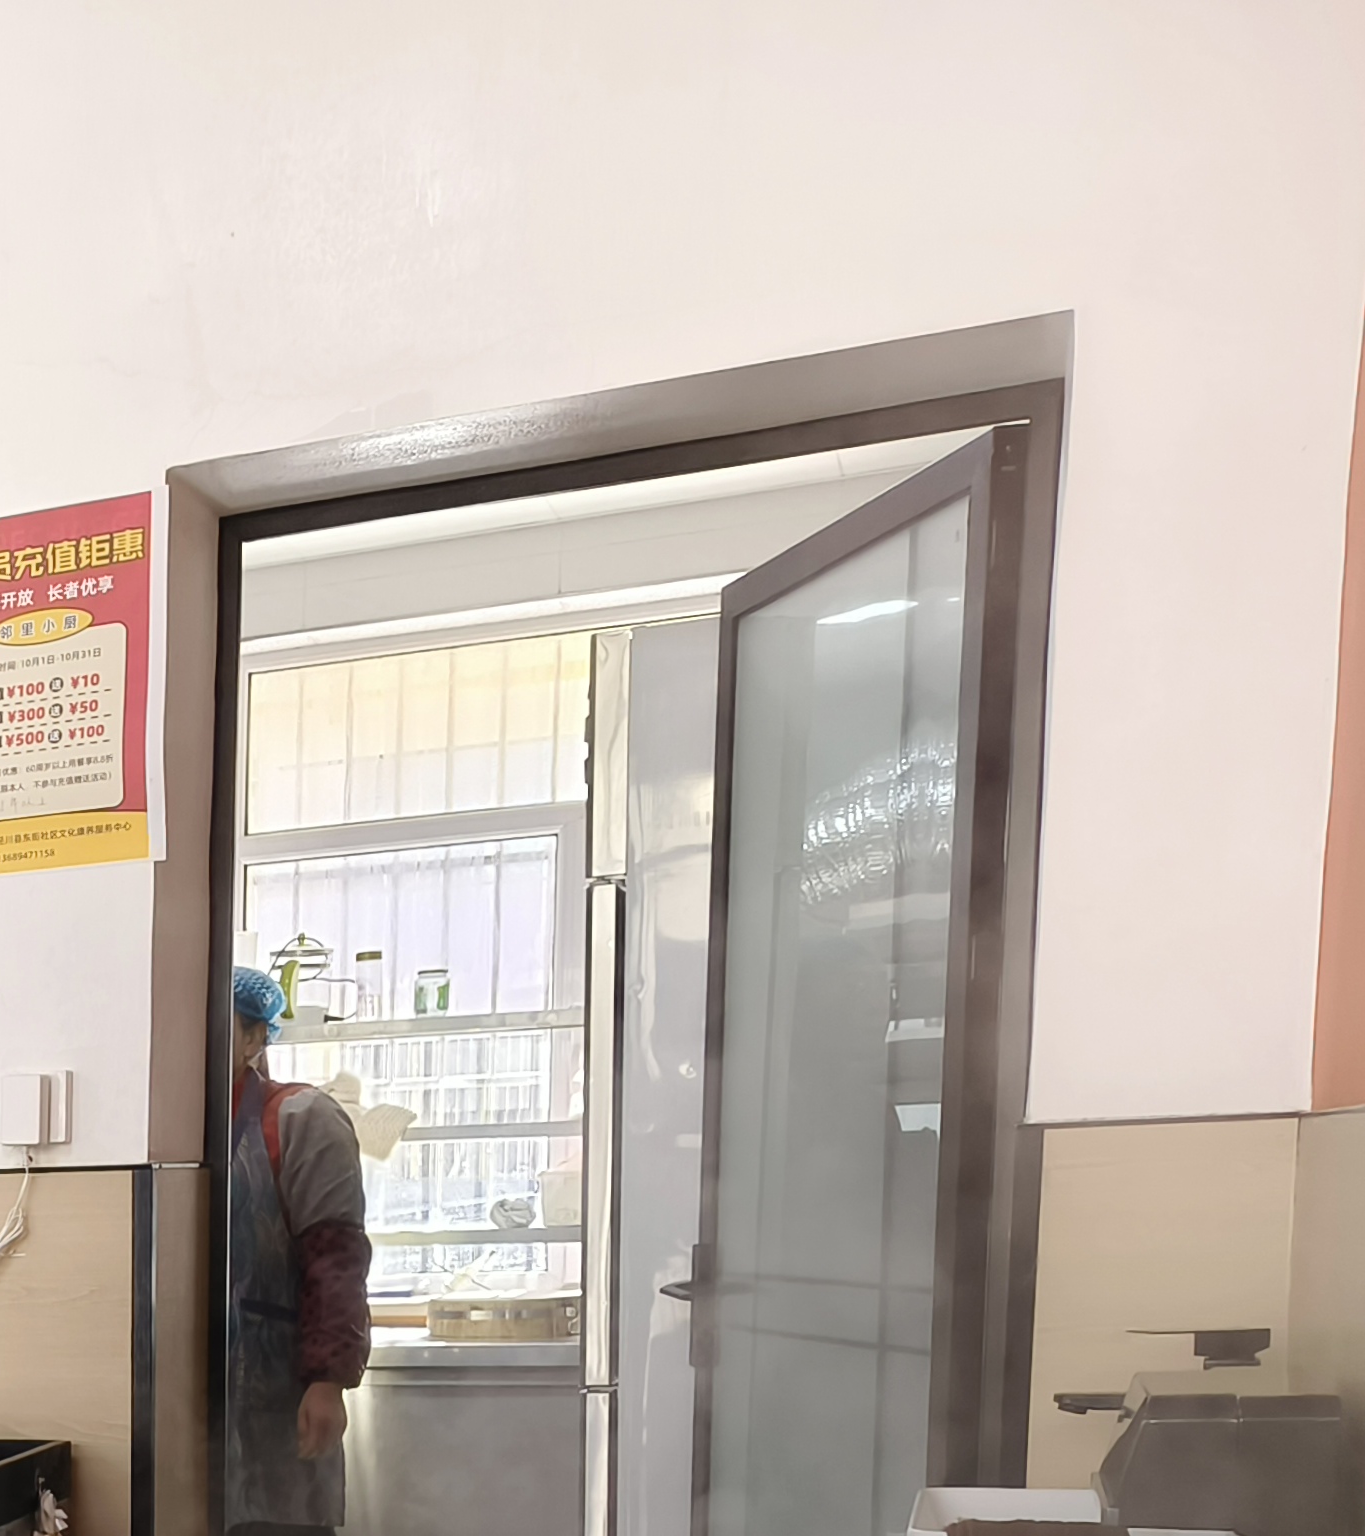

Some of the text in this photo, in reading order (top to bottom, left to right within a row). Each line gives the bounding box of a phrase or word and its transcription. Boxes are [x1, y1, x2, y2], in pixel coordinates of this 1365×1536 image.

[47, 575, 114, 602] 长者优享
[0, 614, 77, 640] 邻里小厨
